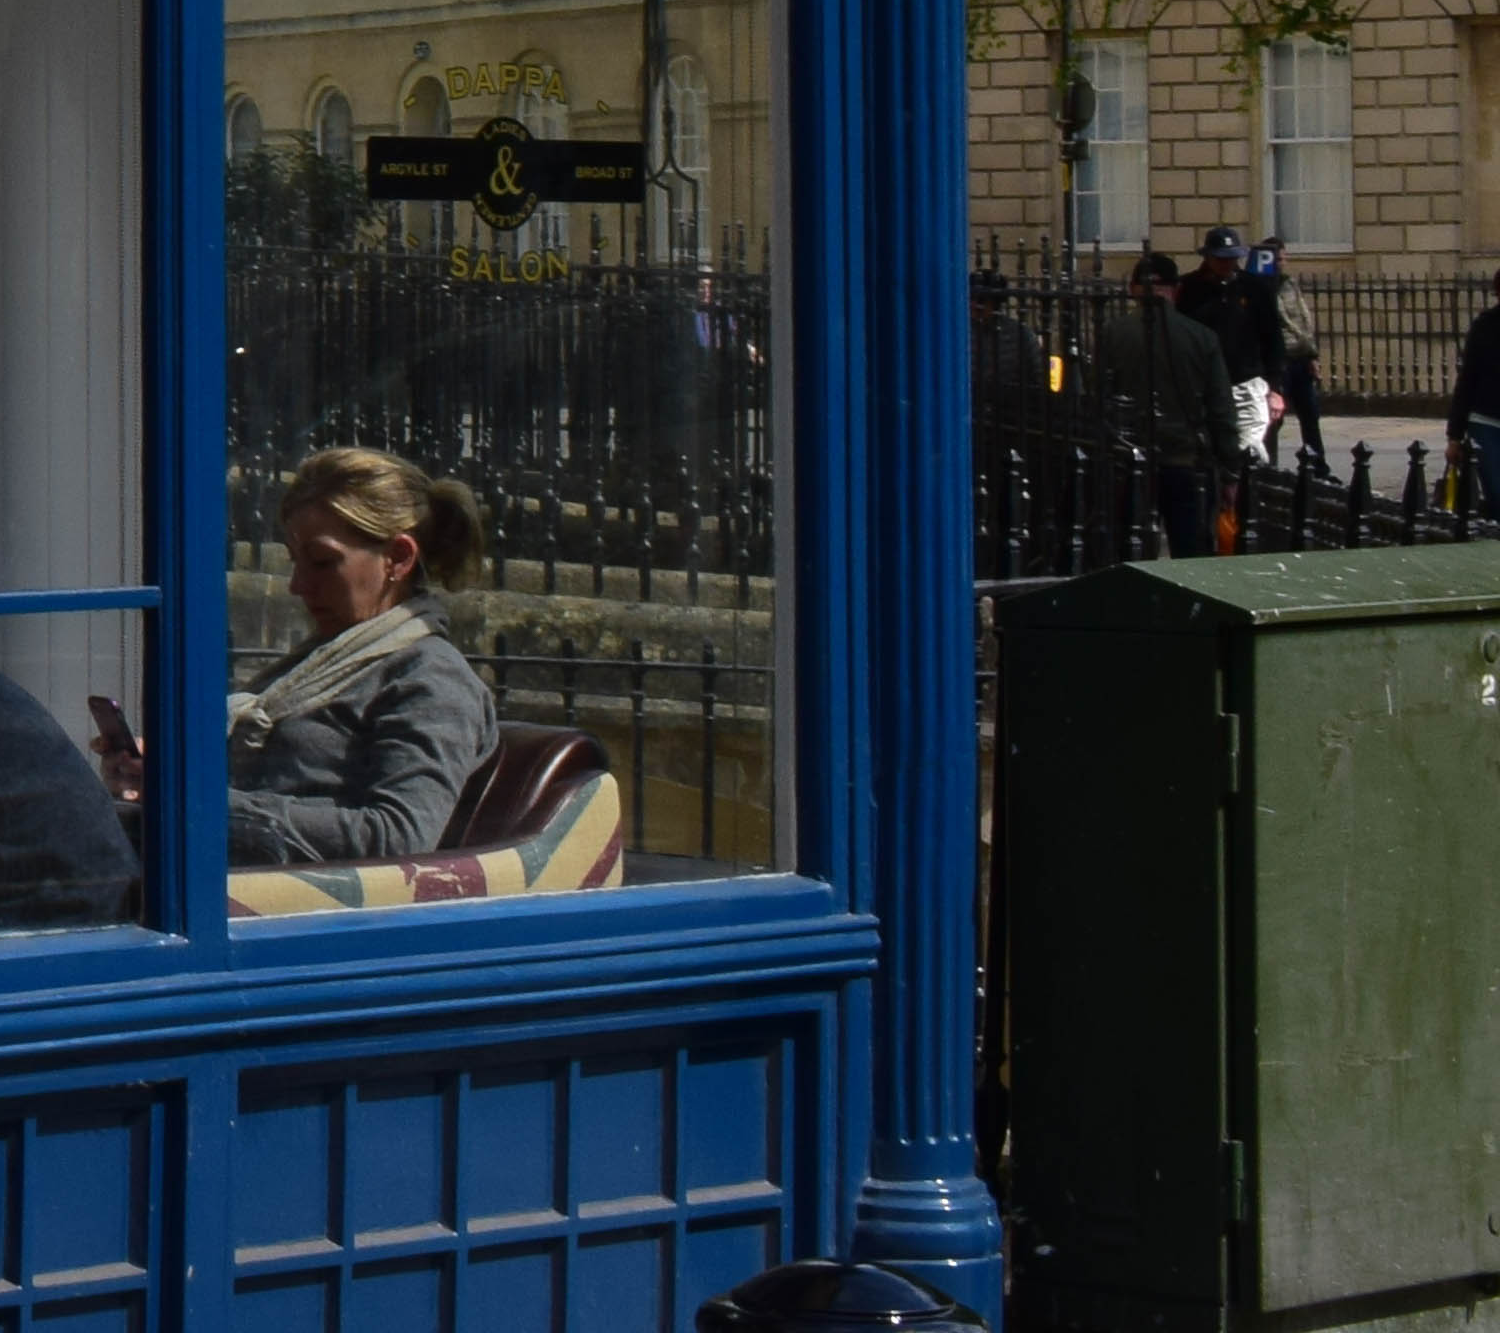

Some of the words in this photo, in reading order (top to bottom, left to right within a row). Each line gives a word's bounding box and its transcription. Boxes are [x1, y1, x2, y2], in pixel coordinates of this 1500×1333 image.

[446, 62, 568, 104] DAPPA
[380, 162, 430, 177] ARGYLE
[432, 163, 451, 177] ST
[488, 144, 525, 195] &
[575, 165, 616, 179] BROAD
[618, 167, 636, 179] ST
[450, 245, 570, 283] SALON
[1256, 249, 1275, 274] P
[1481, 673, 1497, 707] 2
